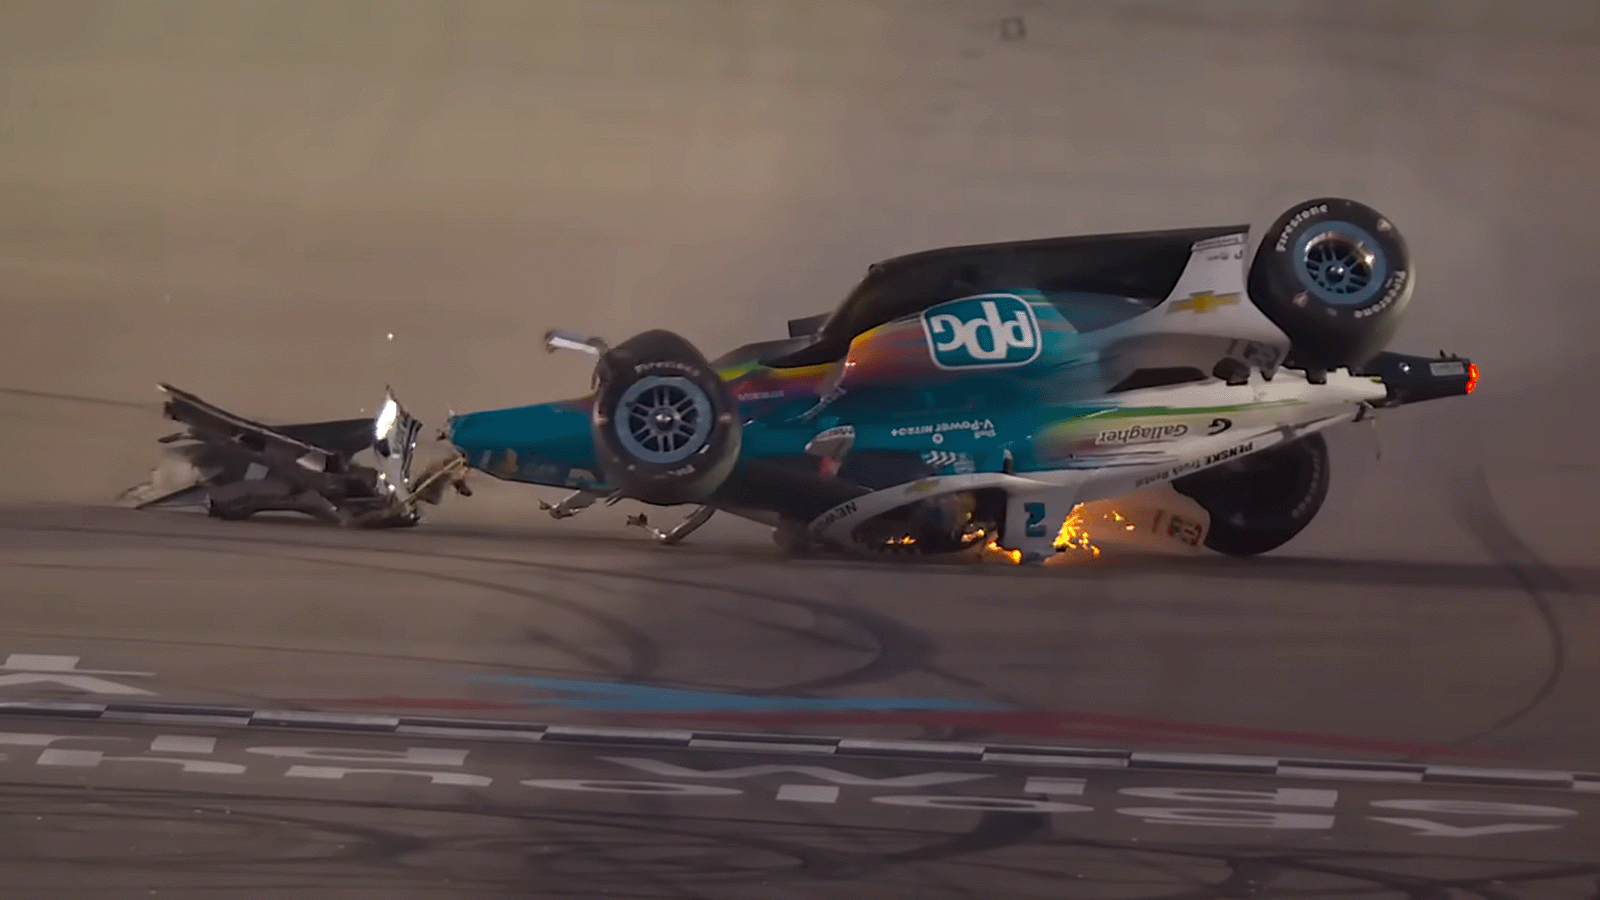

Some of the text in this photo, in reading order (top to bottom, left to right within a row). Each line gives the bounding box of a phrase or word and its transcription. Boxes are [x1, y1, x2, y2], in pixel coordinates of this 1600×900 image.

[1275, 204, 1328, 252] Firestone
[1354, 270, 1406, 319] Firestone
[929, 300, 1035, 360] PPG
[934, 419, 995, 433] V-Power
[1098, 424, 1188, 444] Gallagher
[1172, 459, 1201, 475] Truck
[1205, 441, 1254, 466] PENSKE
[1023, 502, 1047, 538] 2
[595, 755, 1579, 818] Wide
